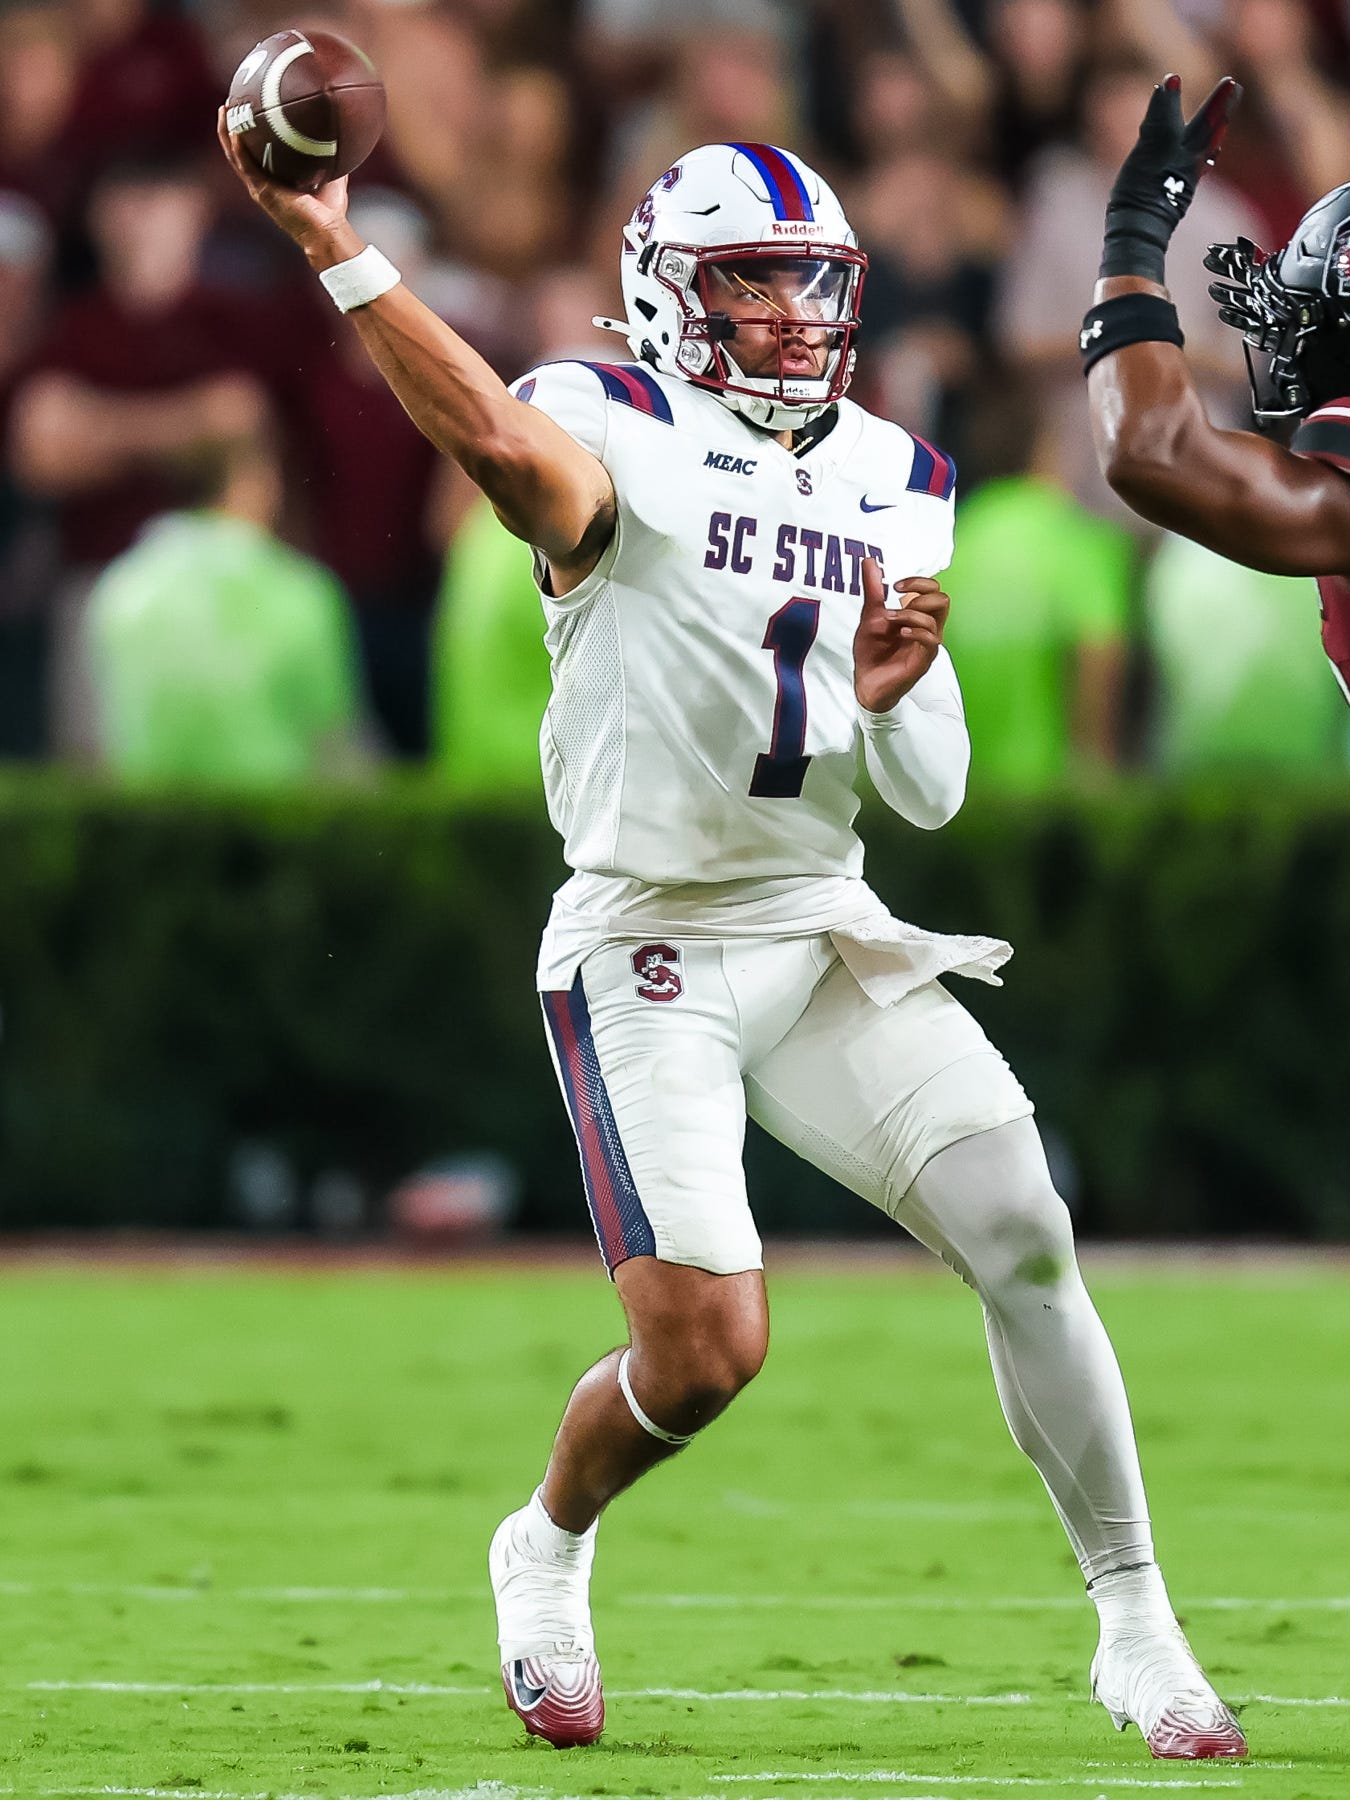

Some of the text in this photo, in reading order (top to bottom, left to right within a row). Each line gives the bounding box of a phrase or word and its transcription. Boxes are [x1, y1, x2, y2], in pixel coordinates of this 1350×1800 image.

[703, 451, 757, 476] MEAC
[703, 511, 889, 600] SC STATE
[747, 596, 821, 799] 1
